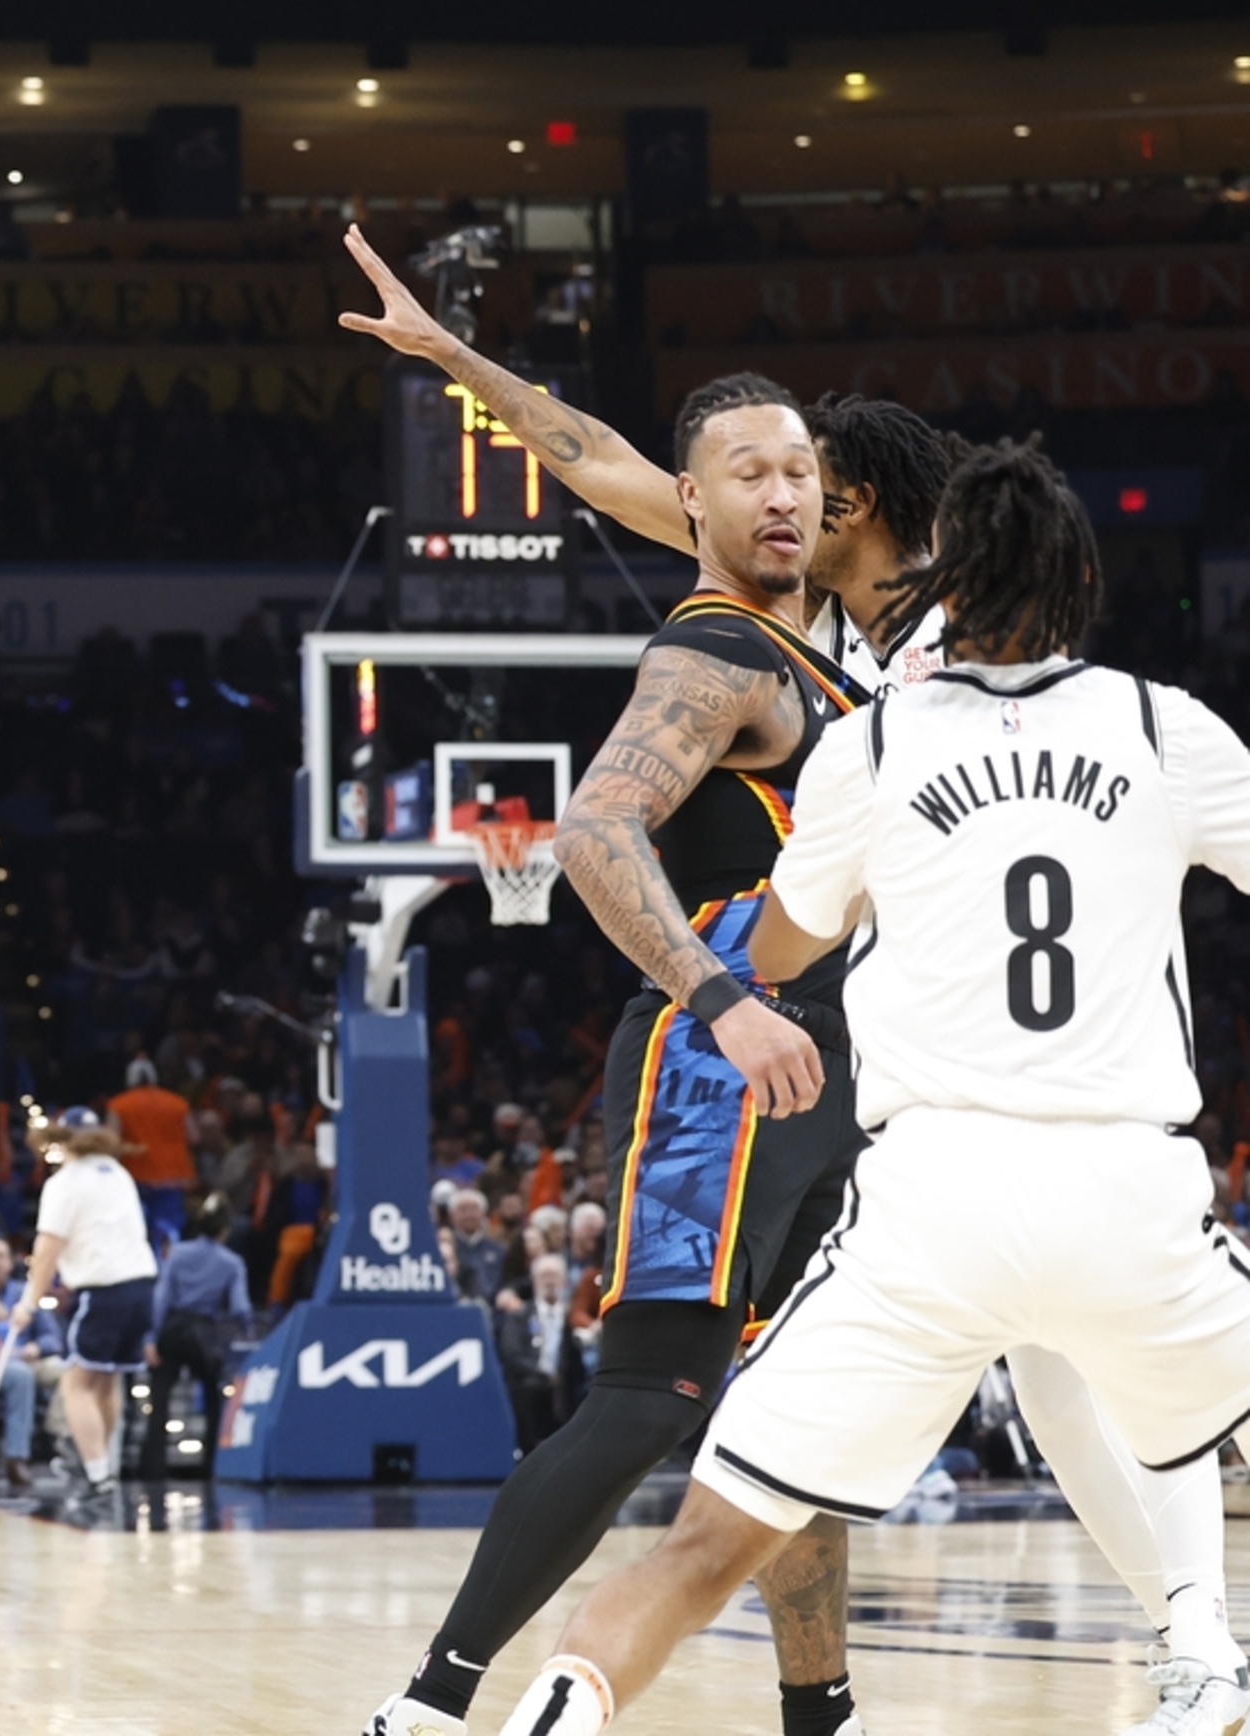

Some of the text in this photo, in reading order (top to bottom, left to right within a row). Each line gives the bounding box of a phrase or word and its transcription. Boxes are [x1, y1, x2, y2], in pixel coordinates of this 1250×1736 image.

[448, 534, 564, 561] TISSOT
[910, 750, 1130, 836] WILLIAMS
[1004, 855, 1075, 1032] 8
[340, 1254, 446, 1292] Health
